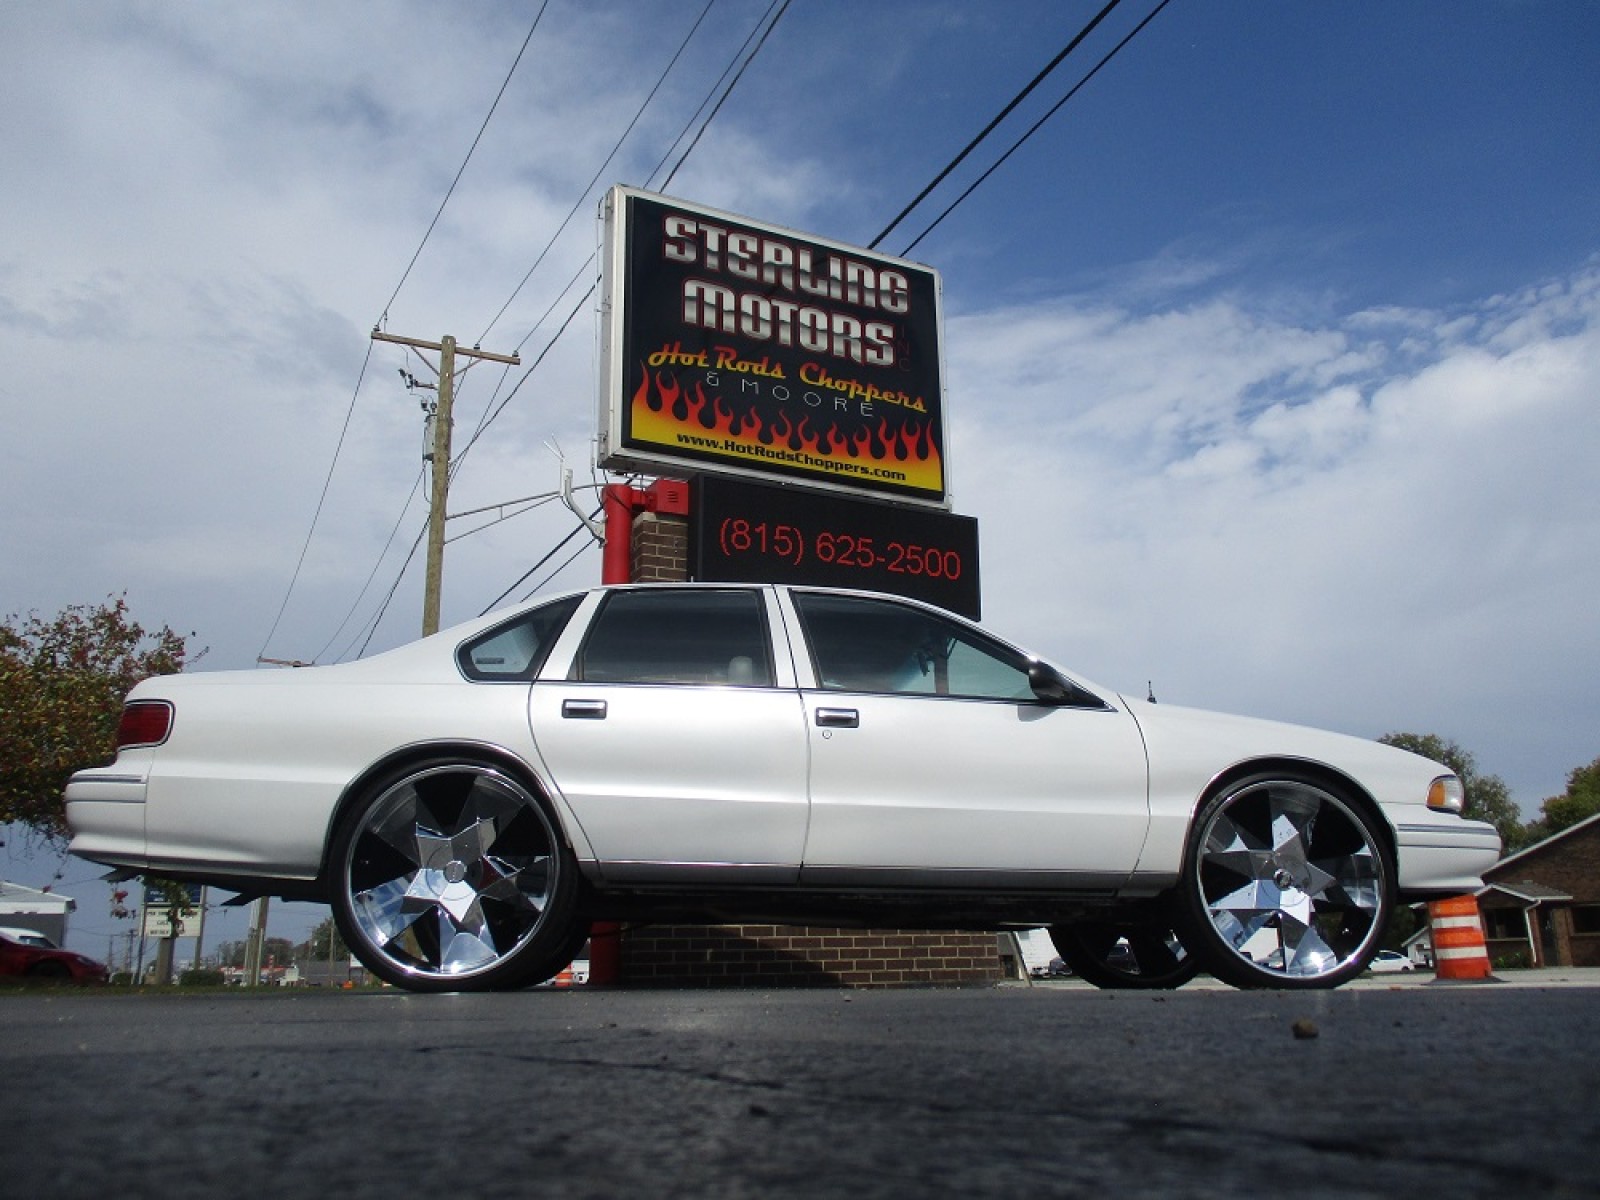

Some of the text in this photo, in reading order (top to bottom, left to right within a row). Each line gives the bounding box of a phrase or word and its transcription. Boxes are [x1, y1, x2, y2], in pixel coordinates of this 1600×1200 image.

[663, 215, 910, 314] STERLING
[682, 278, 896, 367] MOTORS
[648, 341, 927, 413] Hot Rods Choppers
[706, 371, 873, 417] & MOORE
[677, 433, 906, 481] www.HotRodsChoppers.com
[720, 518, 961, 580] (815) 625-2500
